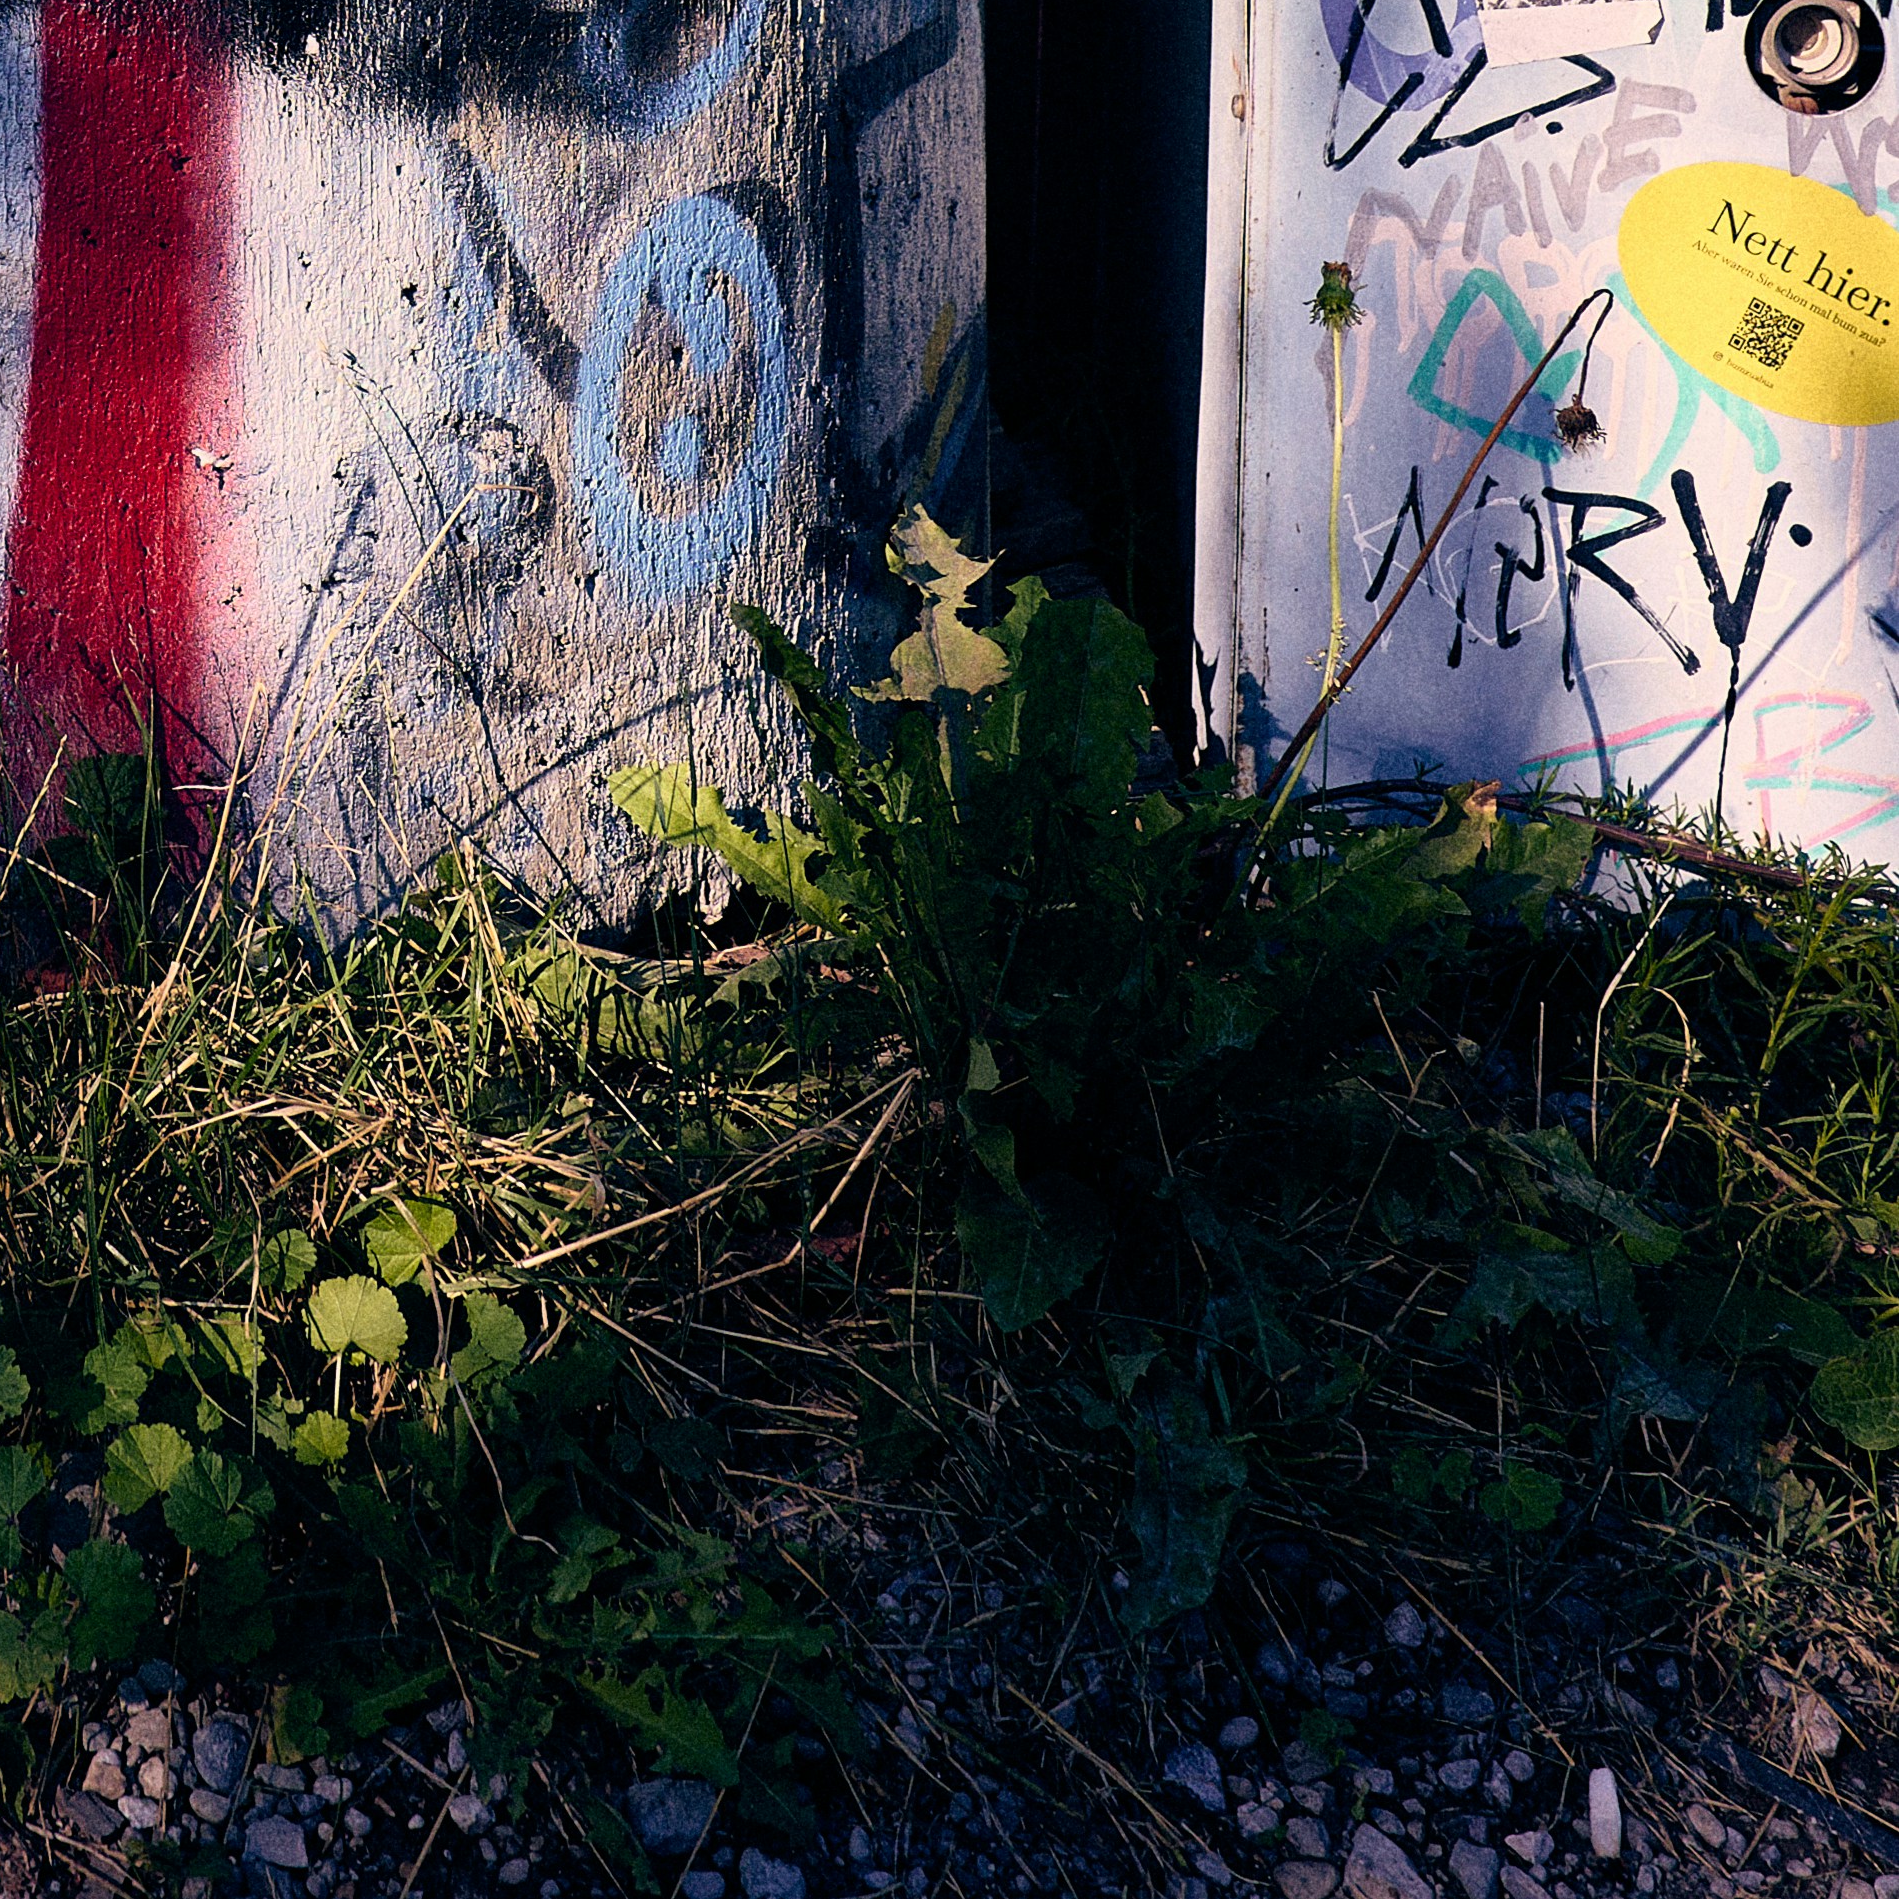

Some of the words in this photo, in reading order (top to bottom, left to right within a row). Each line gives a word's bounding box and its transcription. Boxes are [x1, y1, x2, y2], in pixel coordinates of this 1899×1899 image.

[1692, 239, 1720, 260] Aber
[1722, 255, 1755, 280] waren
[1756, 271, 1775, 290] Sie
[1775, 284, 1808, 308] schon
[1809, 302, 1833, 321] mal
[1832, 312, 1858, 335] bum
[1858, 330, 1888, 349] zua?
[1707, 198, 1799, 273] Nett
[1803, 250, 1891, 327] hier.
